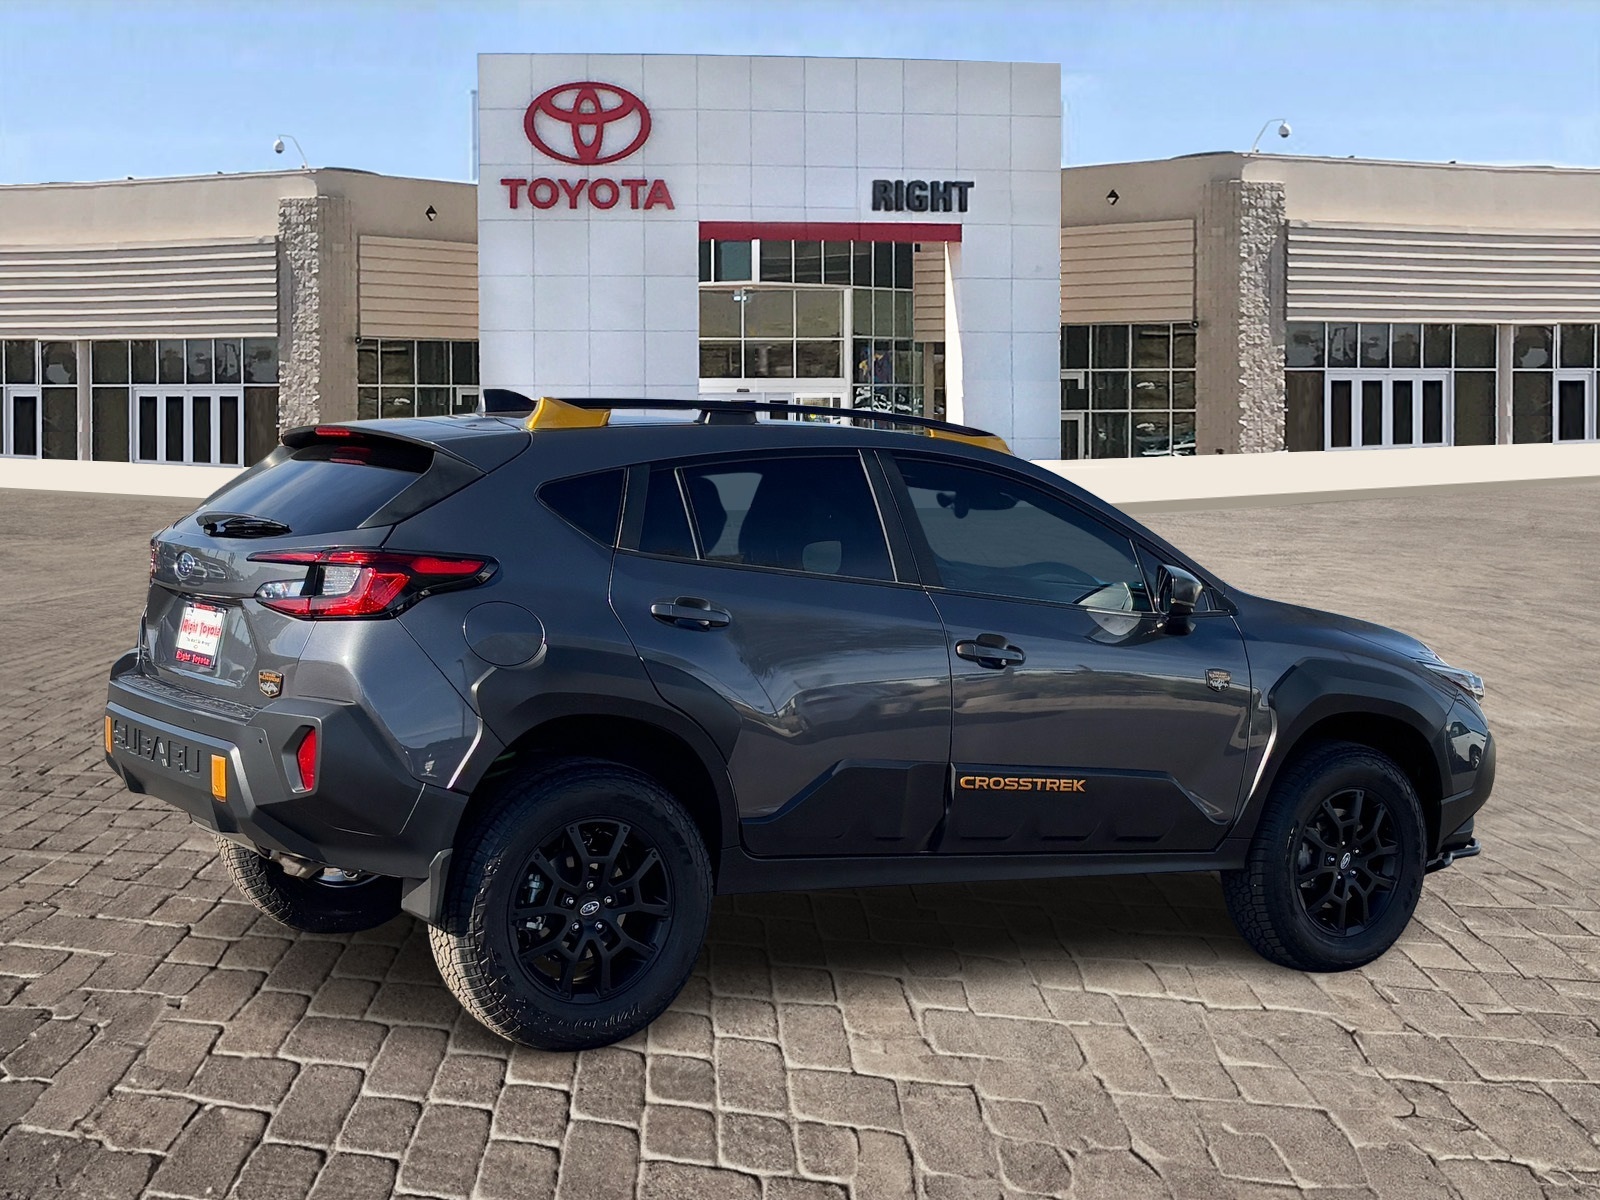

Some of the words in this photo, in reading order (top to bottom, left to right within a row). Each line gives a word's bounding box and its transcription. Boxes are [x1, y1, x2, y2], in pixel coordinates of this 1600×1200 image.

[500, 178, 675, 211] TOYOTA
[871, 179, 975, 213] RIGHT
[199, 622, 222, 638] Toyota
[192, 654, 211, 666] Toyota
[113, 719, 201, 779] SUBARU
[959, 775, 1087, 793] CROSSTREK
